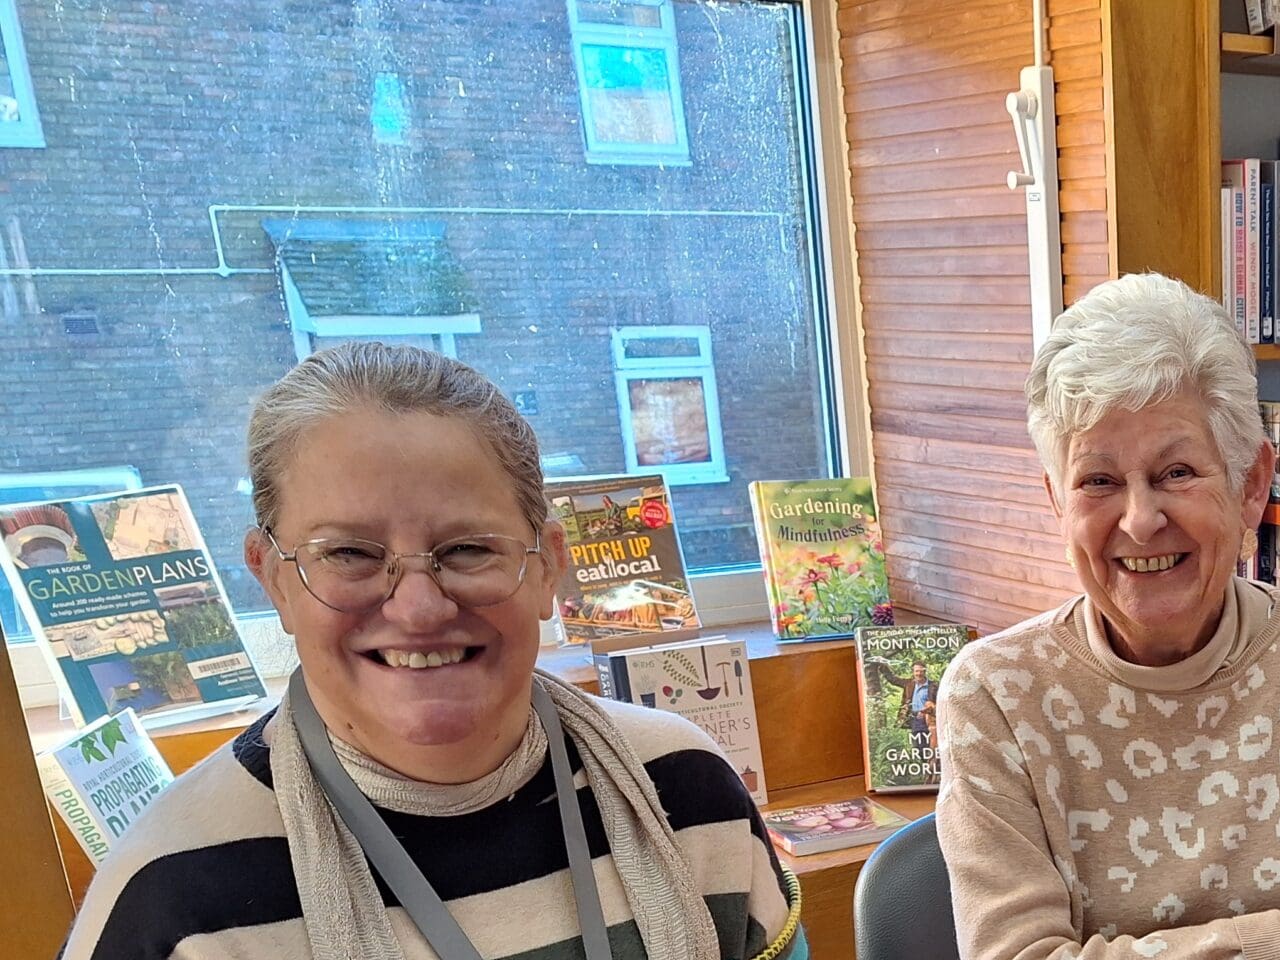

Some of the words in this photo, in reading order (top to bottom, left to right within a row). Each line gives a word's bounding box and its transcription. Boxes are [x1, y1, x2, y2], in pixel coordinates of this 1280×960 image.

[1250, 168, 1258, 206] PARENT
[1250, 210, 1258, 233] TALK
[769, 498, 864, 520] Gardening
[812, 517, 825, 526] for
[777, 523, 866, 543] Mindfulness
[570, 540, 627, 567] PITCH
[628, 536, 652, 558] UP
[867, 638, 920, 650] MONTY
[926, 637, 960, 649] DON
[687, 710, 731, 723] PLETE
[698, 717, 751, 734] NER'S
[908, 732, 932, 745] MY
[90, 756, 162, 817] PROPAGATING
